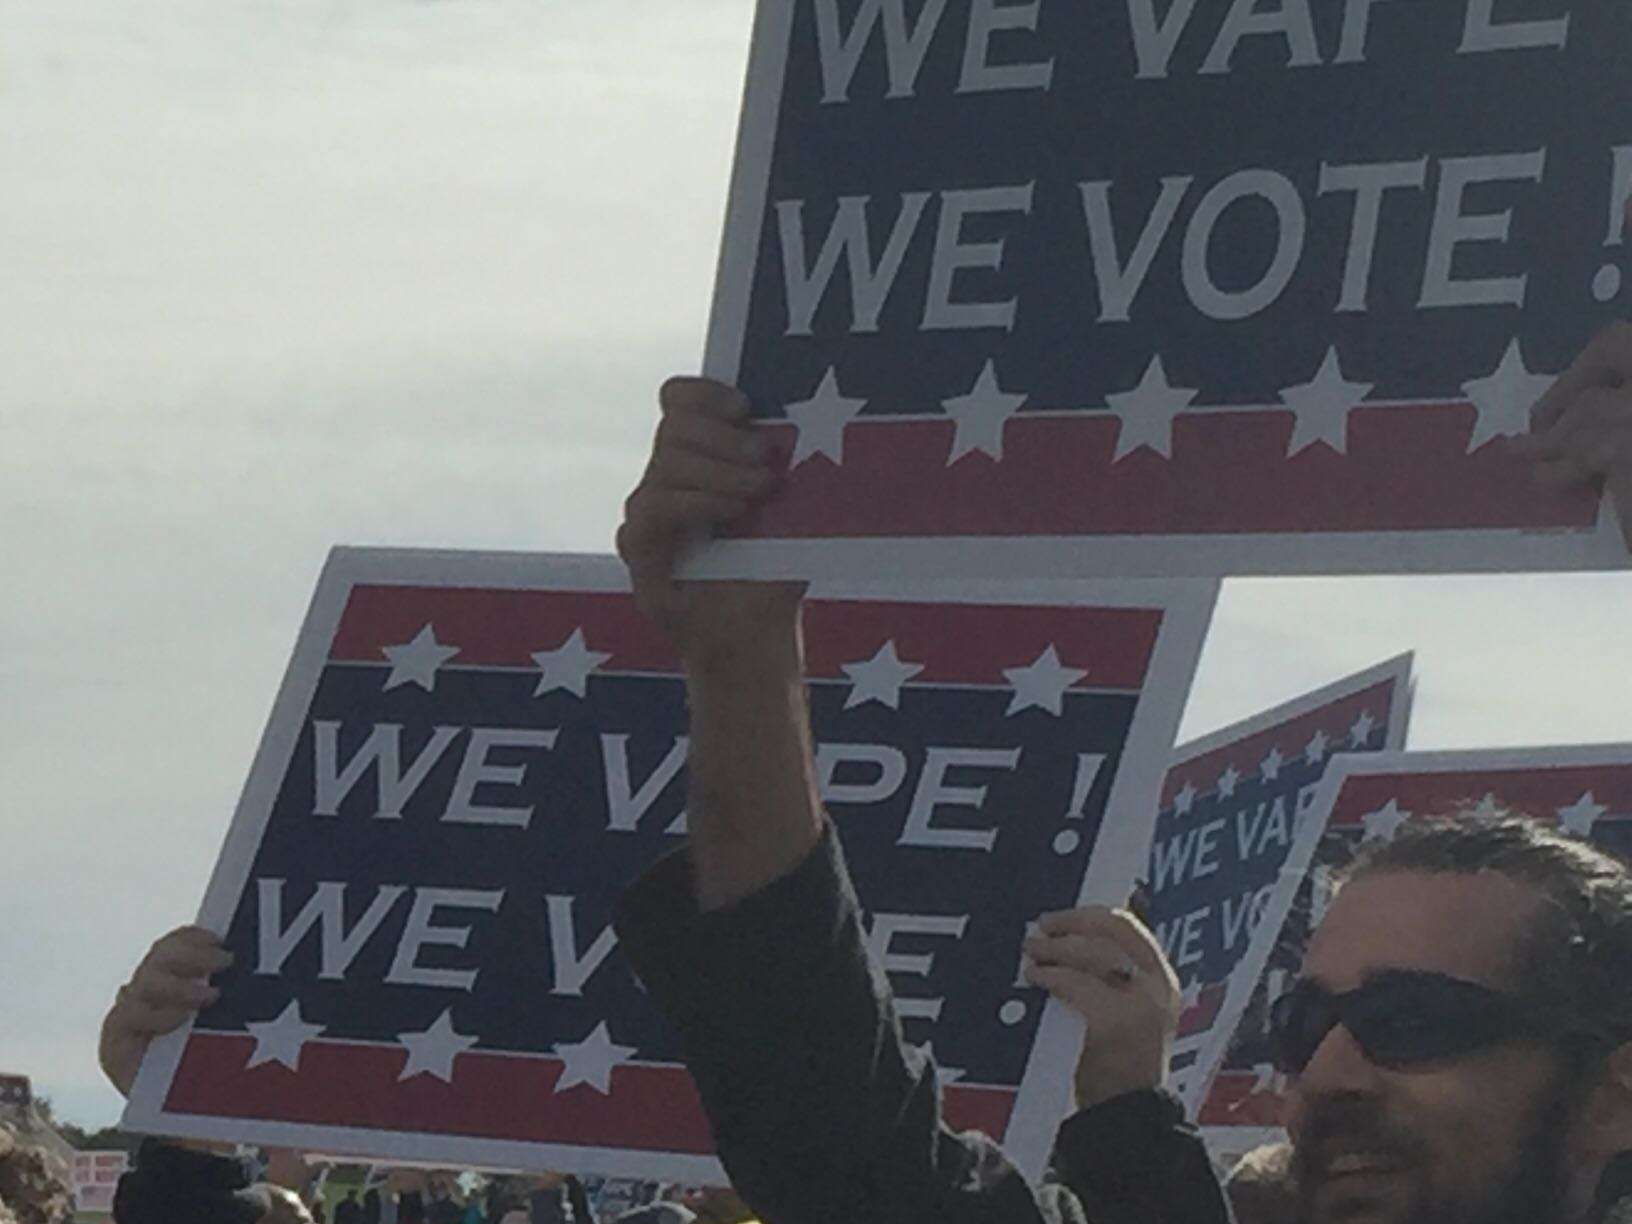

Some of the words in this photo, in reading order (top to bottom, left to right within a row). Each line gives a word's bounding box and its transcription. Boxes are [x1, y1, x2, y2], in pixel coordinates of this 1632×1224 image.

[815, 0, 1058, 103] WE
[774, 179, 1036, 336] WE
[1077, 146, 1546, 322] VOTE
[308, 719, 563, 829] WE
[599, 733, 1024, 853] VPE
[1153, 818, 1226, 893] WE
[1236, 781, 1320, 860] VAP
[255, 876, 505, 993] WE
